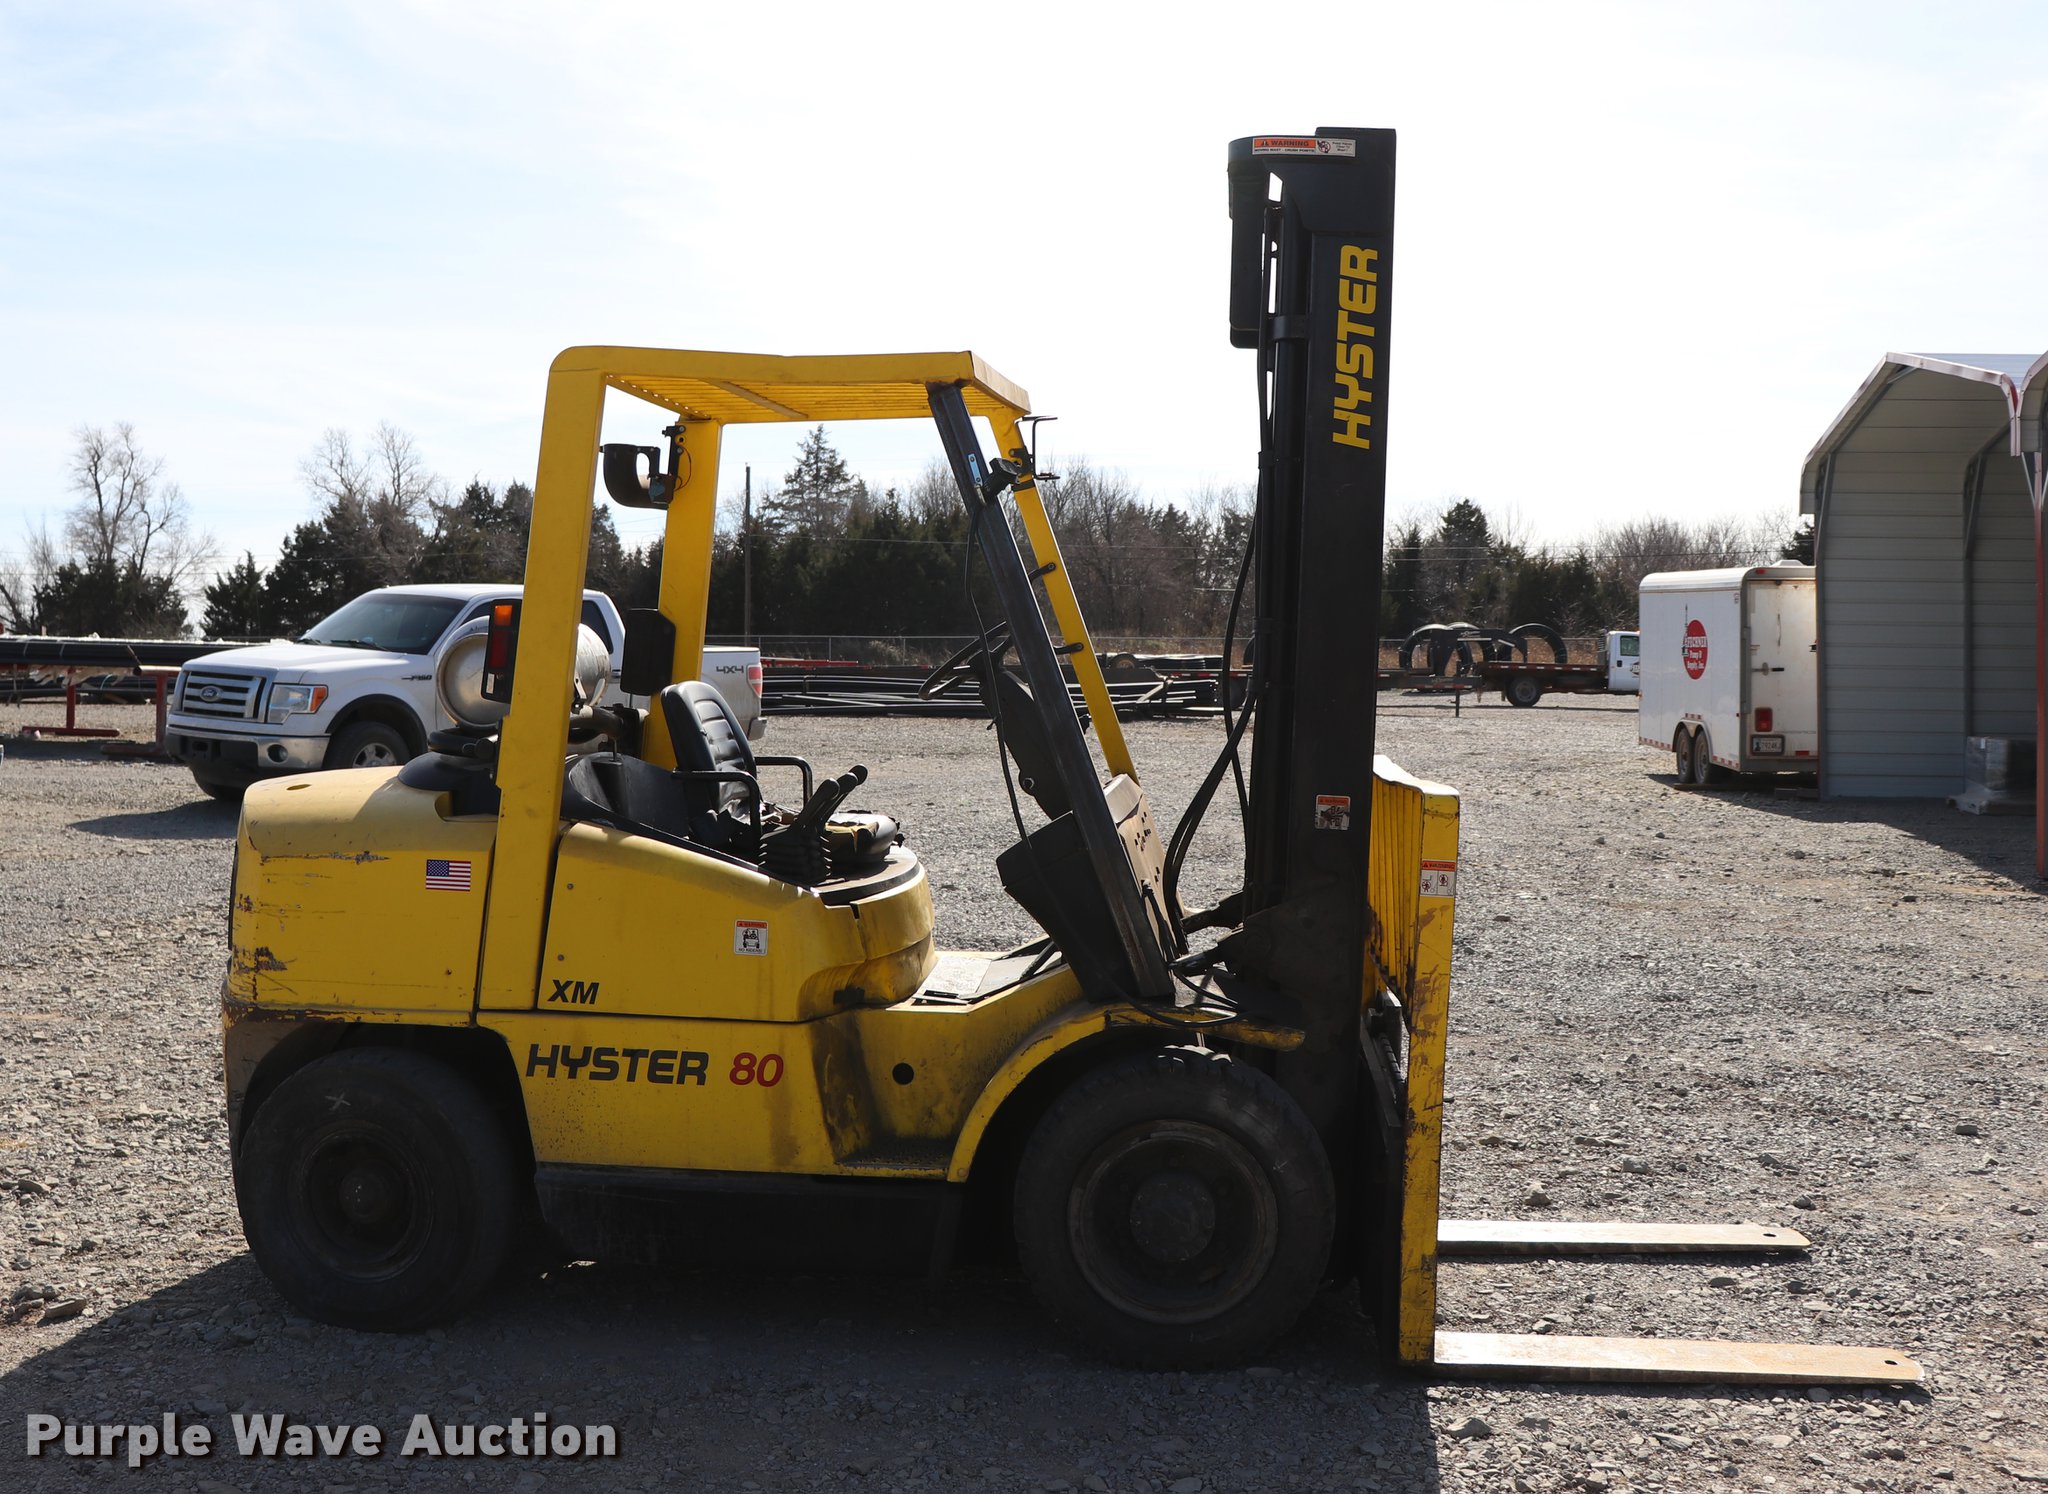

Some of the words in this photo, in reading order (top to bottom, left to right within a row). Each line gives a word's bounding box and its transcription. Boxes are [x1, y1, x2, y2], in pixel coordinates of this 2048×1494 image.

[1332, 244, 1378, 449] HYSTER
[547, 979, 600, 1005] XM
[525, 1043, 709, 1086] HYSTER
[729, 1052, 784, 1087] 80
